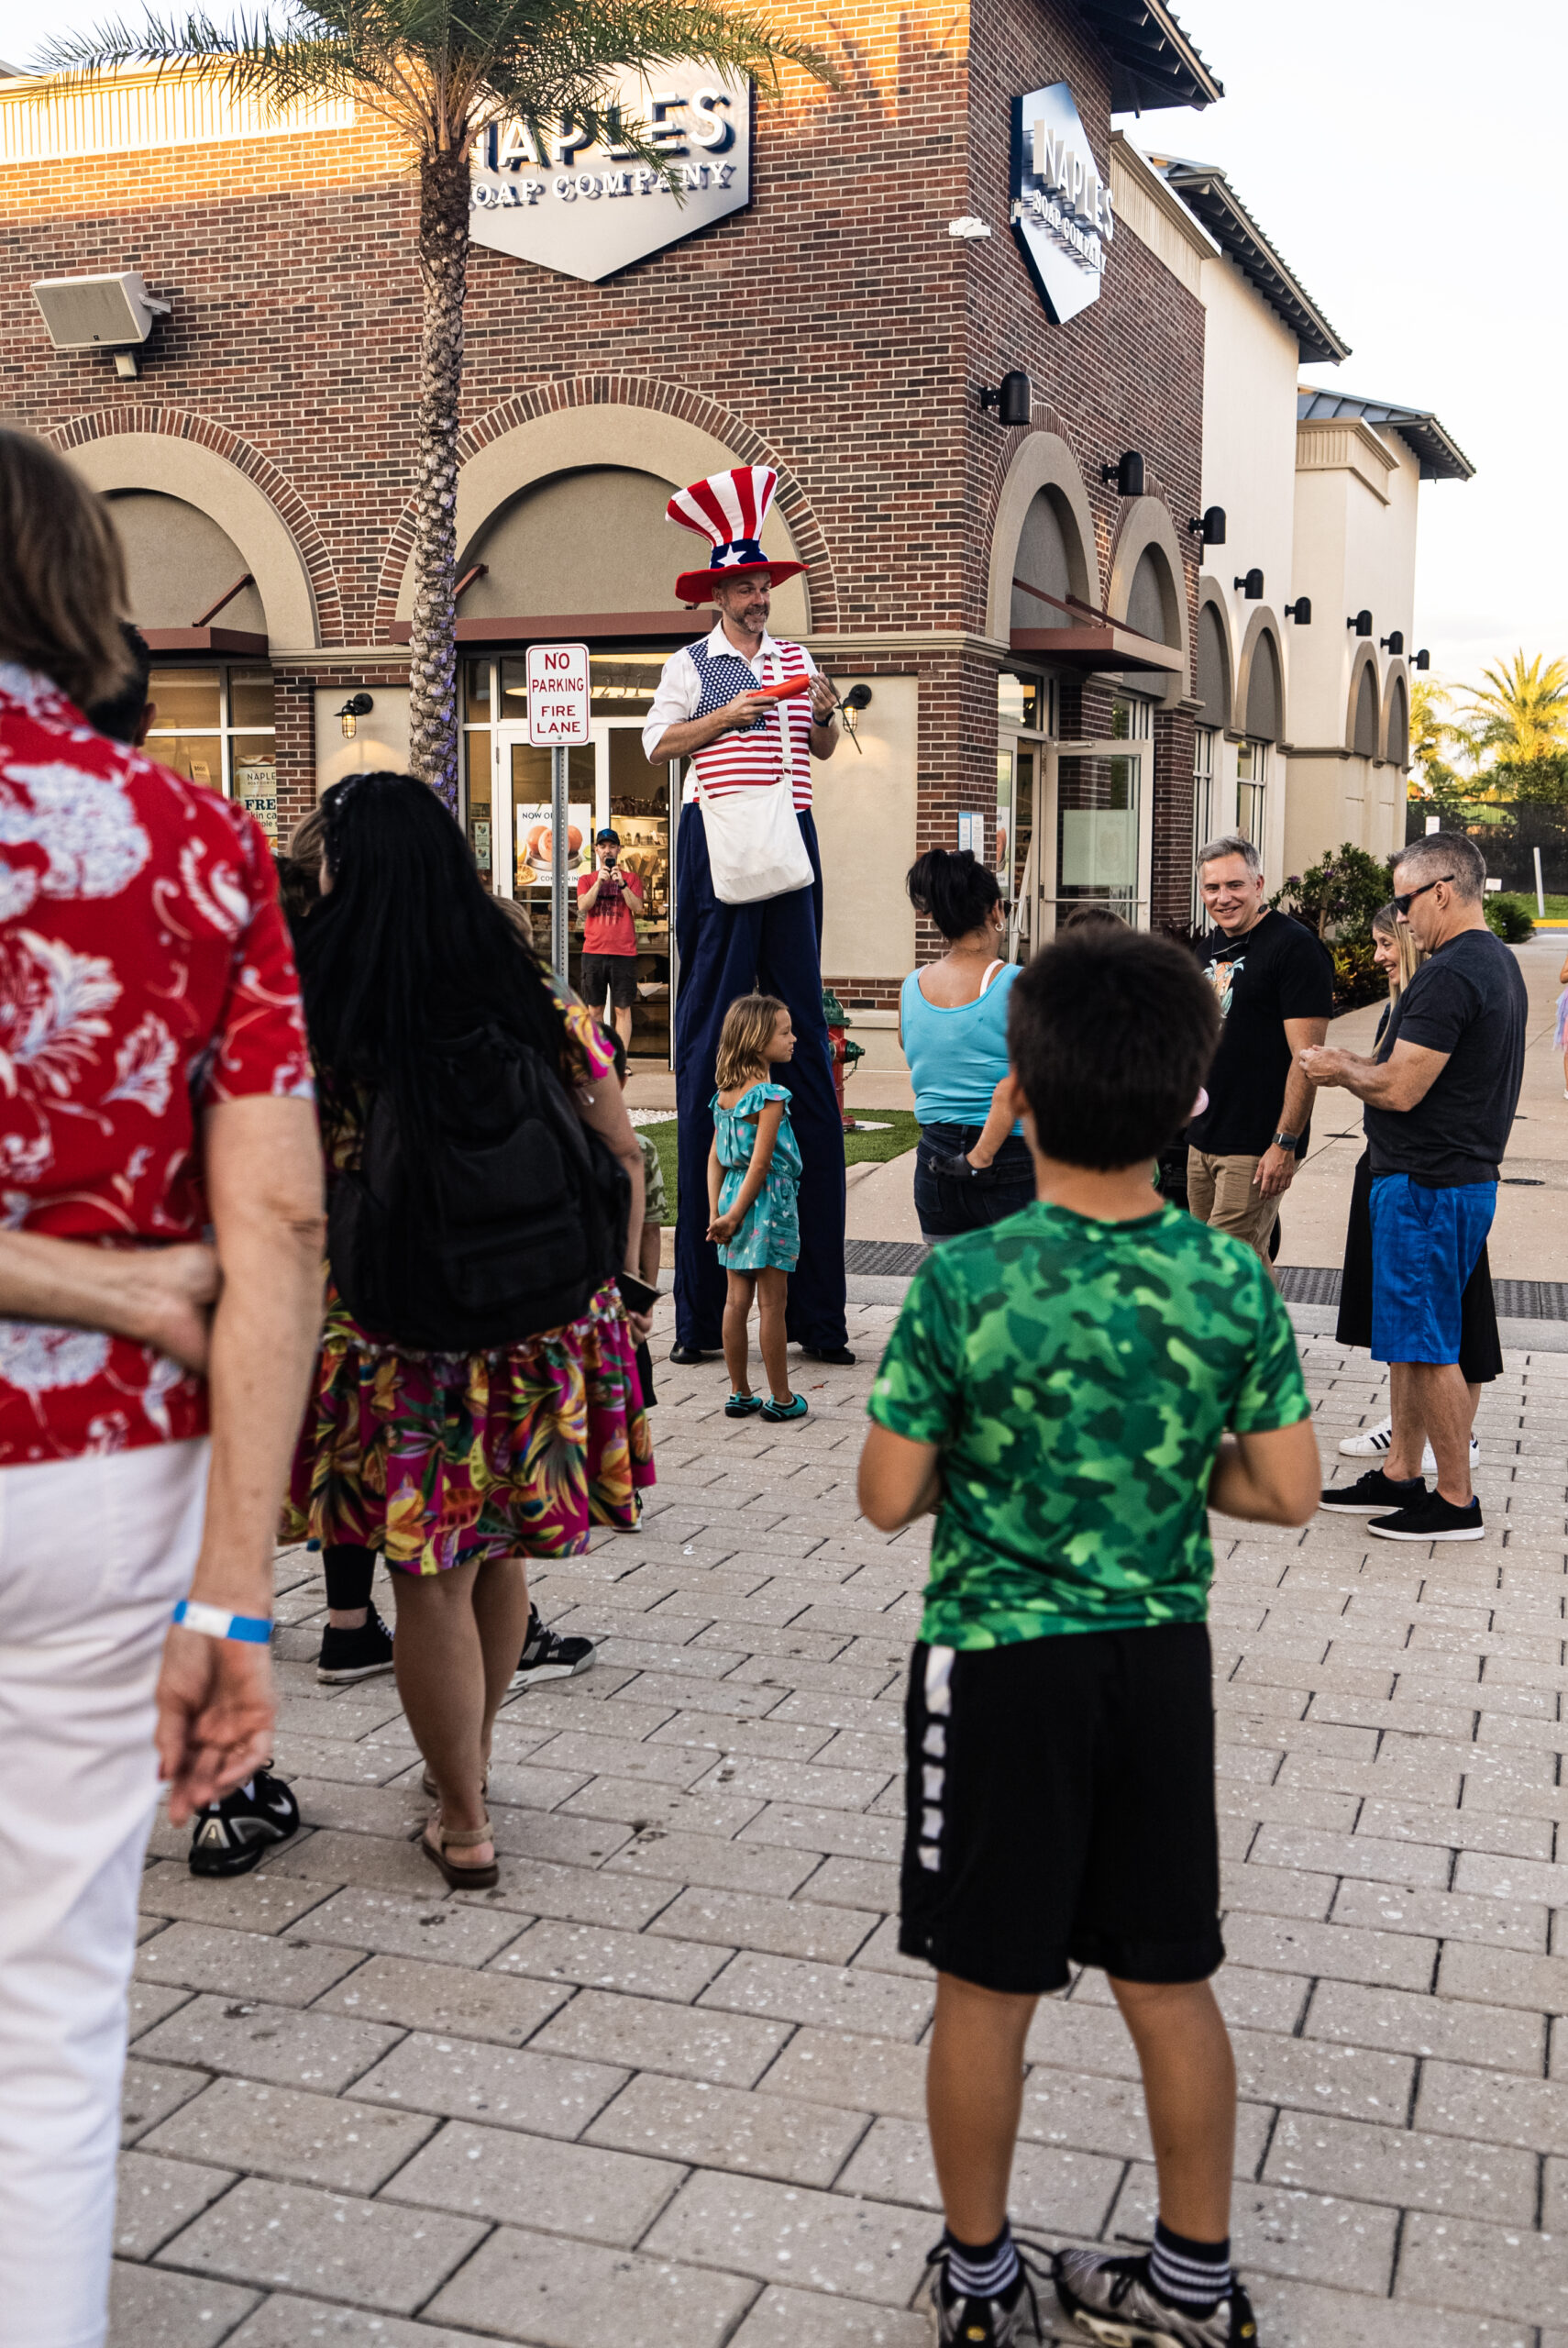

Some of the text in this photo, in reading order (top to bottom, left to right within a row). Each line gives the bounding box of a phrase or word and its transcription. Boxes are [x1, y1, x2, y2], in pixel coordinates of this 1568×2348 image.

[471, 160, 728, 206] OAP COMPANY
[1033, 119, 1114, 241] NAPLES
[1032, 189, 1061, 231] SOAP
[544, 652, 570, 670] NO
[532, 677, 585, 693] PARKING
[541, 704, 576, 717] FIRE
[536, 721, 581, 734] LANE
[247, 772, 276, 781] NAPLE
[245, 799, 276, 811] FRE
[522, 812, 542, 820] NOW
